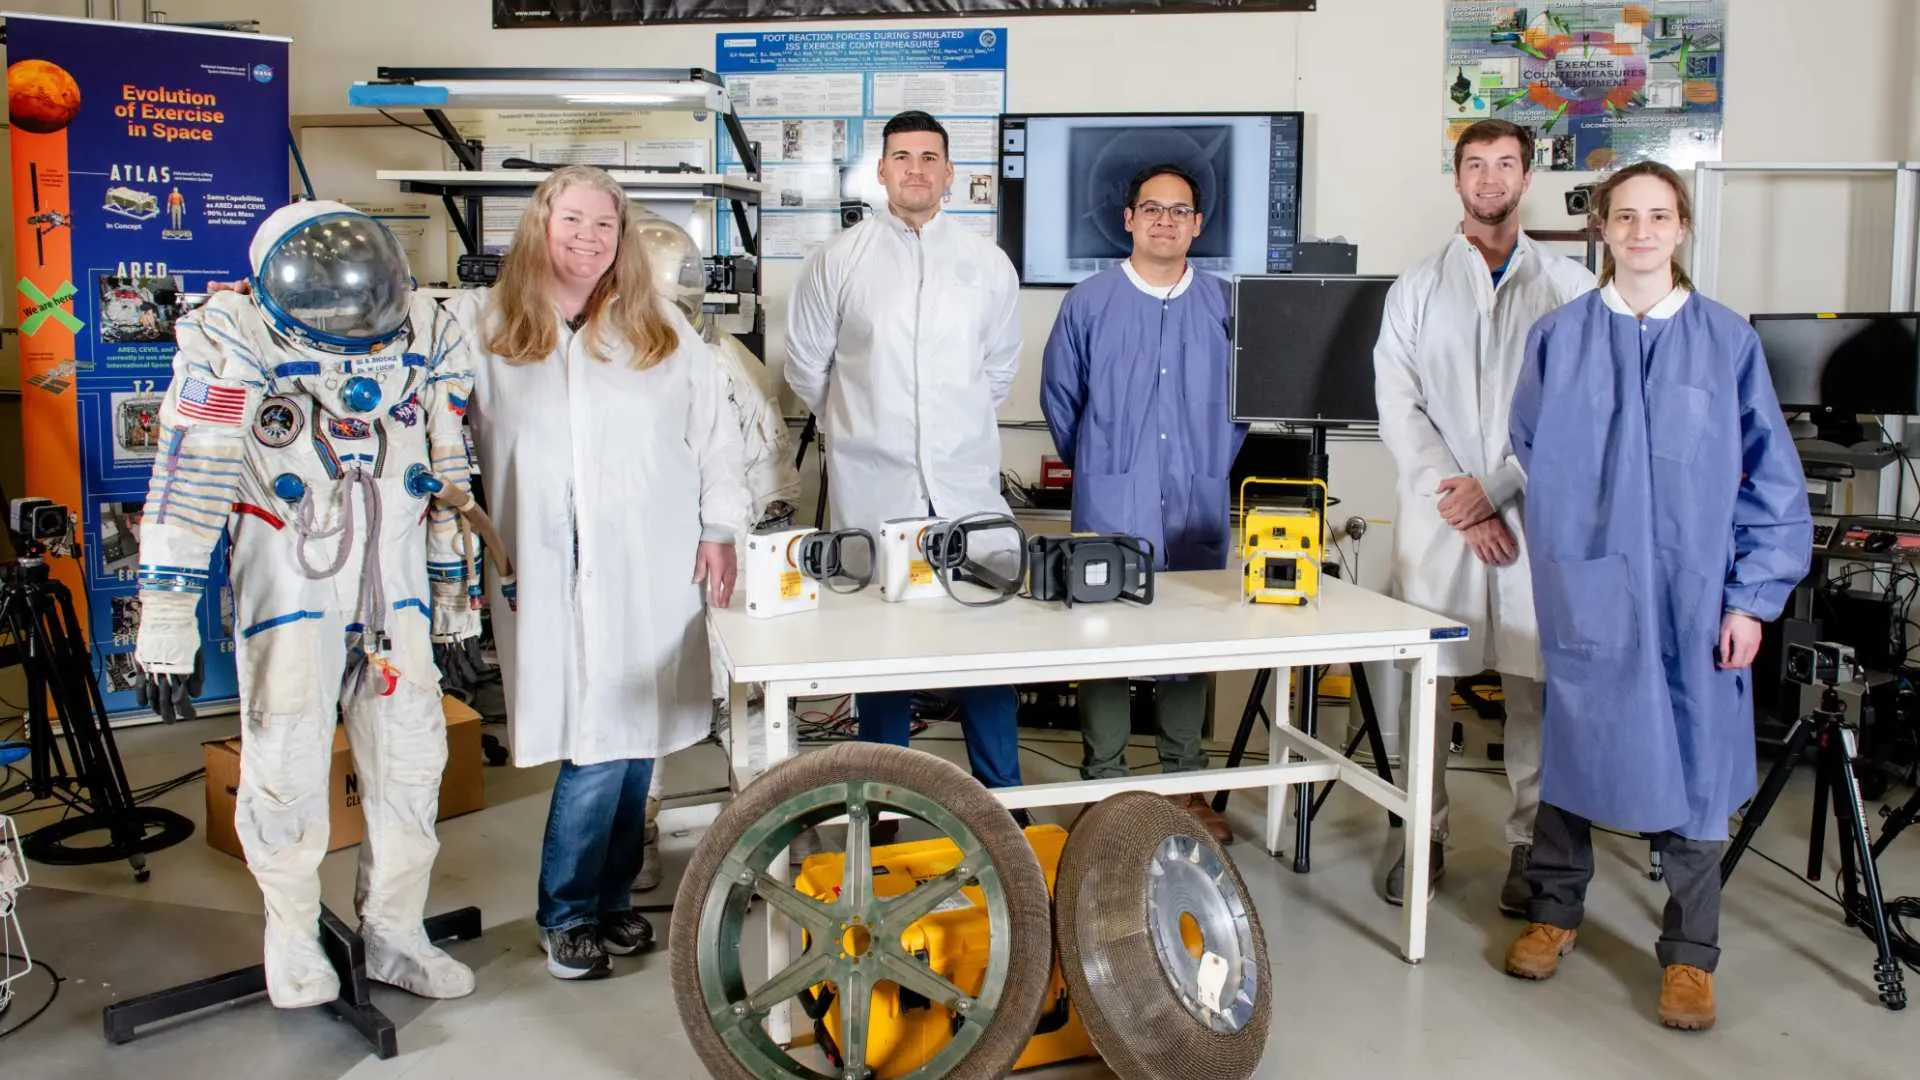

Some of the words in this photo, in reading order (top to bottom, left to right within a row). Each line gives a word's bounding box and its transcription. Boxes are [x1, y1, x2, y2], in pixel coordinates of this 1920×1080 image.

[763, 34, 786, 45] FOOT
[788, 33, 833, 44] REACTION
[836, 33, 871, 43] FORCES
[874, 32, 910, 42] DURING
[912, 31, 964, 42] SIMULATED
[785, 43, 801, 53] ISS
[803, 43, 846, 53] EXERCISE
[849, 40, 940, 52] COUNTERMEASURES
[1555, 60, 1615, 69] EXERCISE
[1523, 69, 1647, 80] COUNTERMEASURES
[1540, 79, 1628, 88] DEVELOPMENT
[123, 85, 217, 106] Evolution
[115, 103, 136, 118] of
[142, 104, 224, 123] Exercise
[128, 121, 147, 137] in
[153, 123, 213, 142] Space
[110, 164, 171, 183] ATLAS
[226, 195, 264, 203] Capabilities
[114, 222, 143, 231] Concept
[117, 262, 167, 280] ARED
[23, 305, 39, 318] We
[40, 302, 53, 311] are
[53, 294, 76, 306] here
[132, 379, 155, 398] T2
